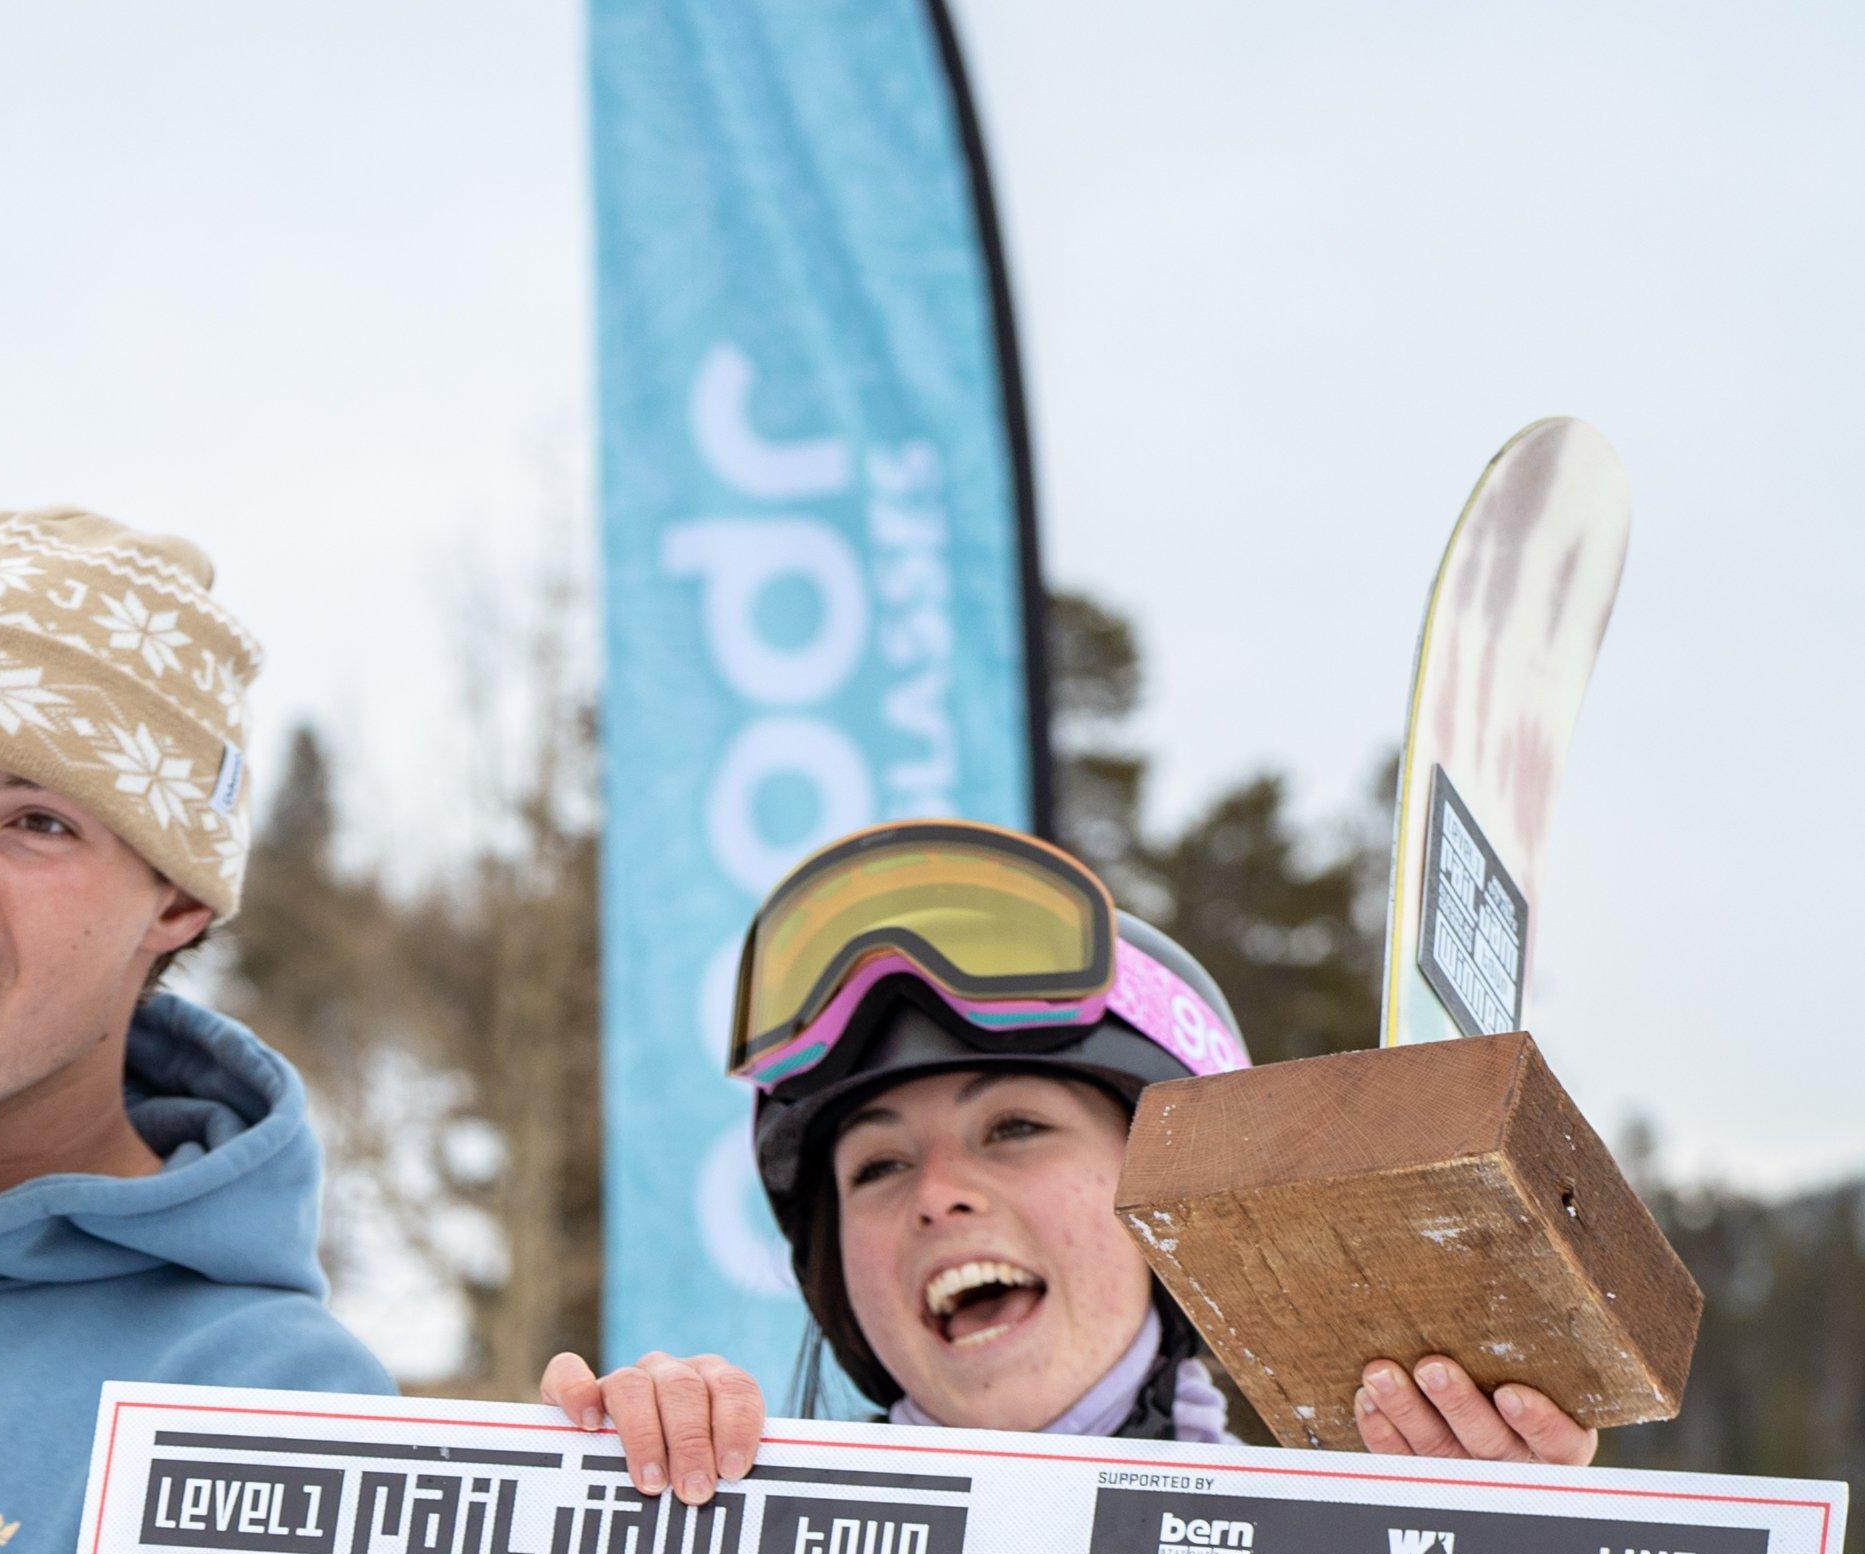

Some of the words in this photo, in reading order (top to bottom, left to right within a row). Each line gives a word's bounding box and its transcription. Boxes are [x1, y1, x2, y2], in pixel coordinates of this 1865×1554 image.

[867, 436, 958, 820] LASSES
[1098, 1472, 1190, 1488] SUPPORTED
[1195, 1477, 1213, 1489] BY
[1160, 1512, 1253, 1547] bern
